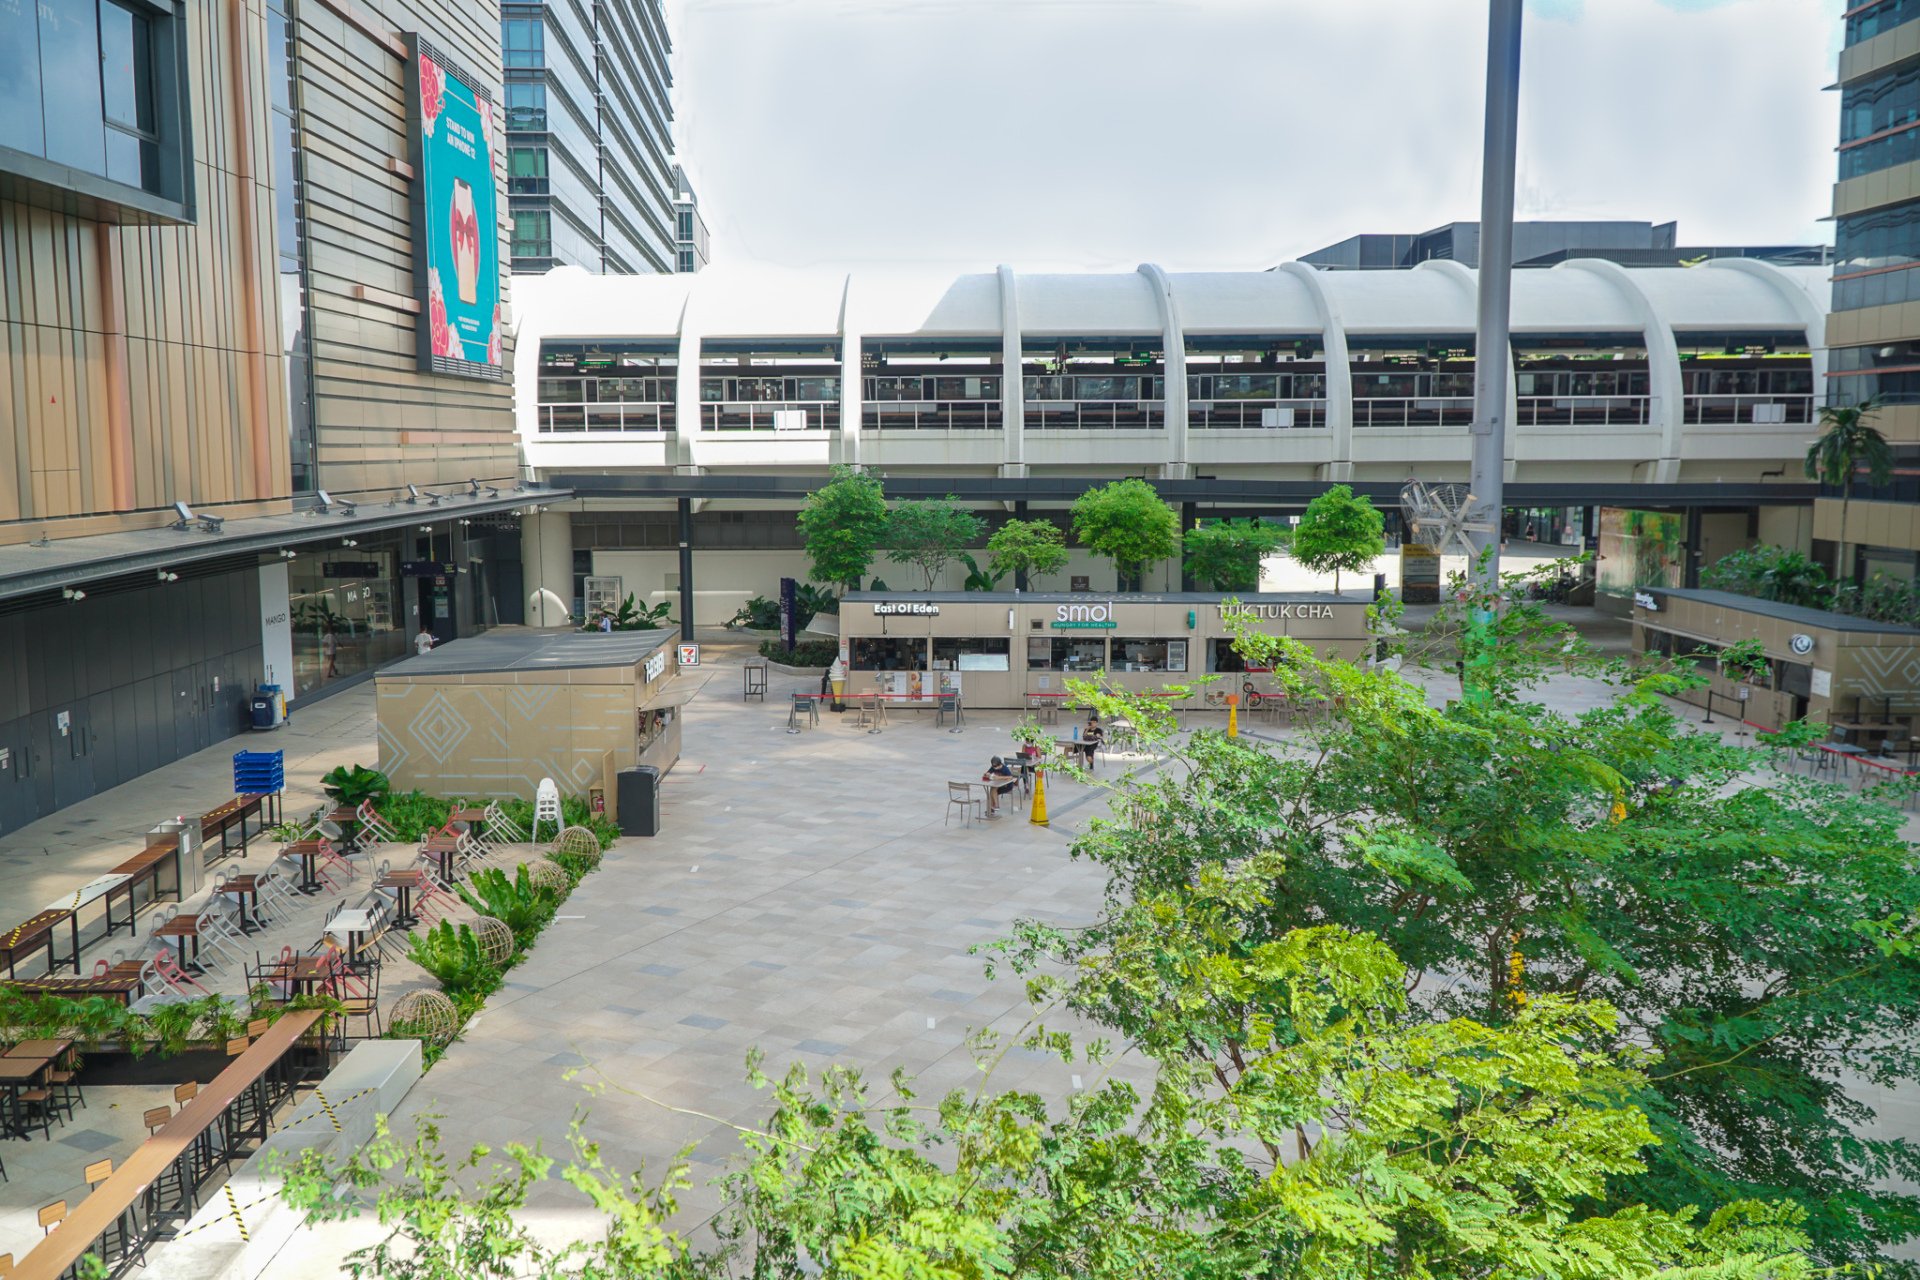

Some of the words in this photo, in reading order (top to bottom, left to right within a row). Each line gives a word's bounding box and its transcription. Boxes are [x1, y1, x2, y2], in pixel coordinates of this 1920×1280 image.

[874, 604, 896, 613] East
[897, 603, 912, 613] Of
[913, 603, 939, 613] Eden
[1057, 601, 1113, 622] smol
[1217, 605, 1253, 618] TUK
[1256, 604, 1291, 618] TUK
[1296, 604, 1334, 618] CHA
[265, 612, 286, 626] MANGO
